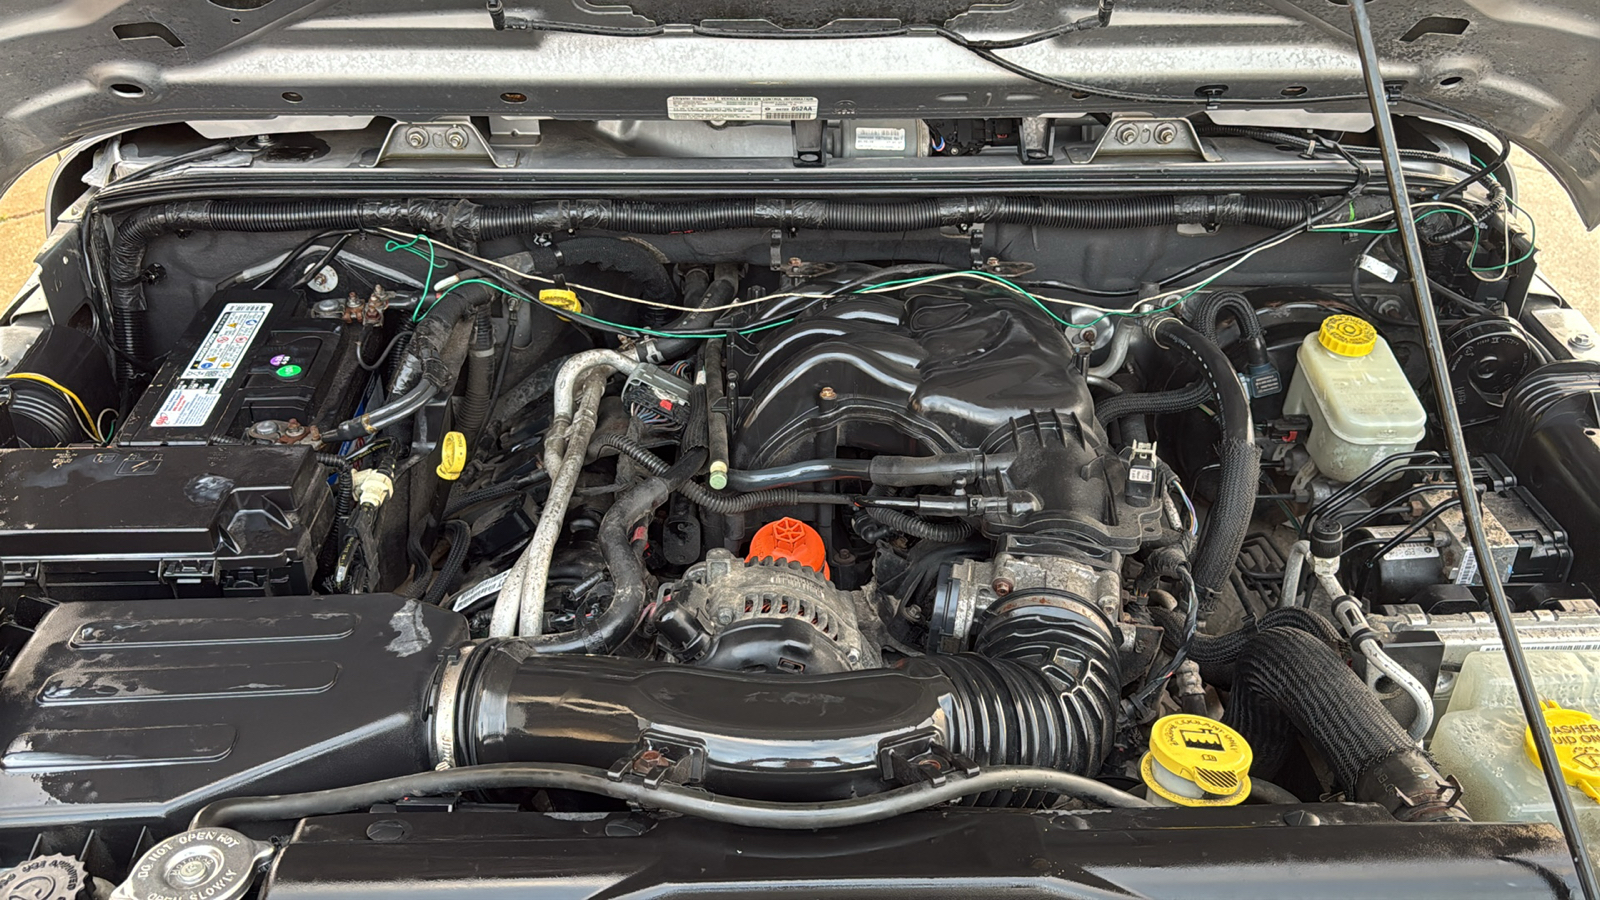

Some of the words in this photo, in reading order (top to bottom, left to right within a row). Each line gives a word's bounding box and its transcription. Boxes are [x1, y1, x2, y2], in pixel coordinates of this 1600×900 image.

[1551, 723, 1600, 735] ASHER
[1551, 734, 1578, 745] UID
[138, 864, 153, 879] DO
[148, 843, 173, 862] NOT
[178, 831, 217, 844] OPEN
[216, 833, 241, 848] HOT
[189, 869, 237, 900] SLOWLY
